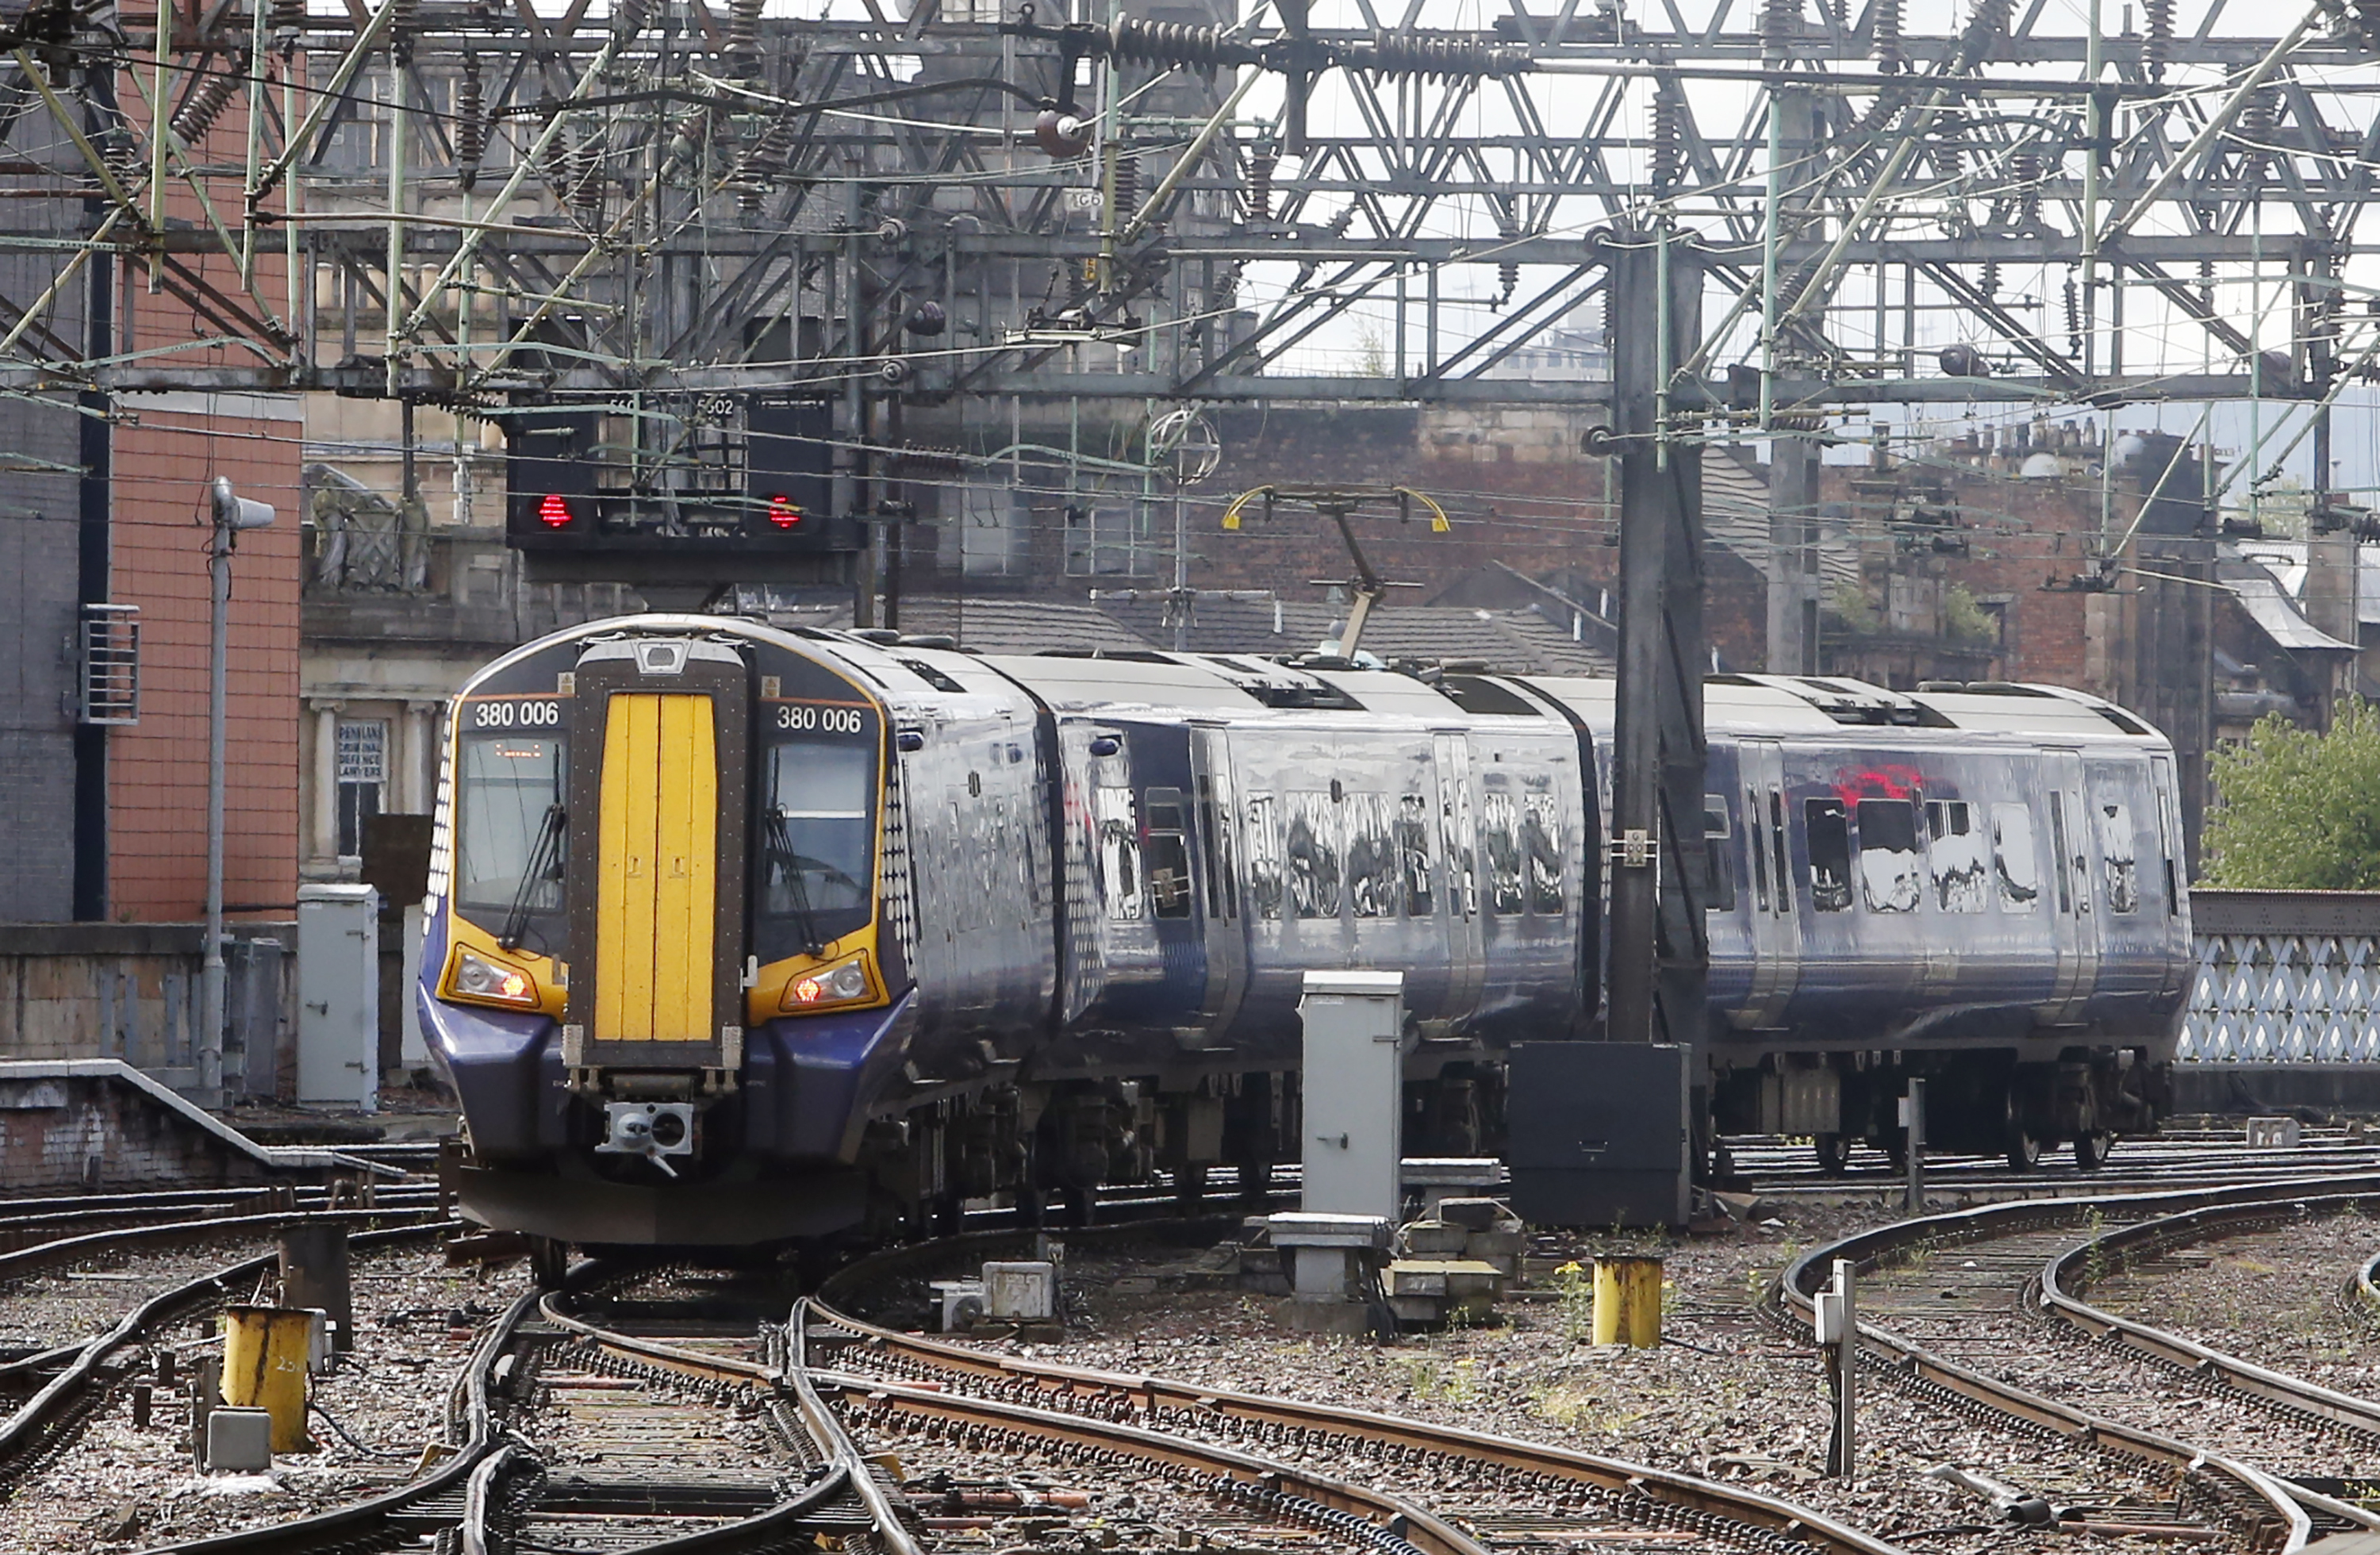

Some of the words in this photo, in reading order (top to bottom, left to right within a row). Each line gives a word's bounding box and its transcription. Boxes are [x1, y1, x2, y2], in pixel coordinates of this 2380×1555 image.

[476, 702, 514, 727] 380
[520, 701, 559, 725] 006
[777, 705, 816, 730] 380
[823, 708, 862, 733] 006
[339, 754, 380, 764] DEFENCE
[338, 766, 381, 777] LAWYERS
